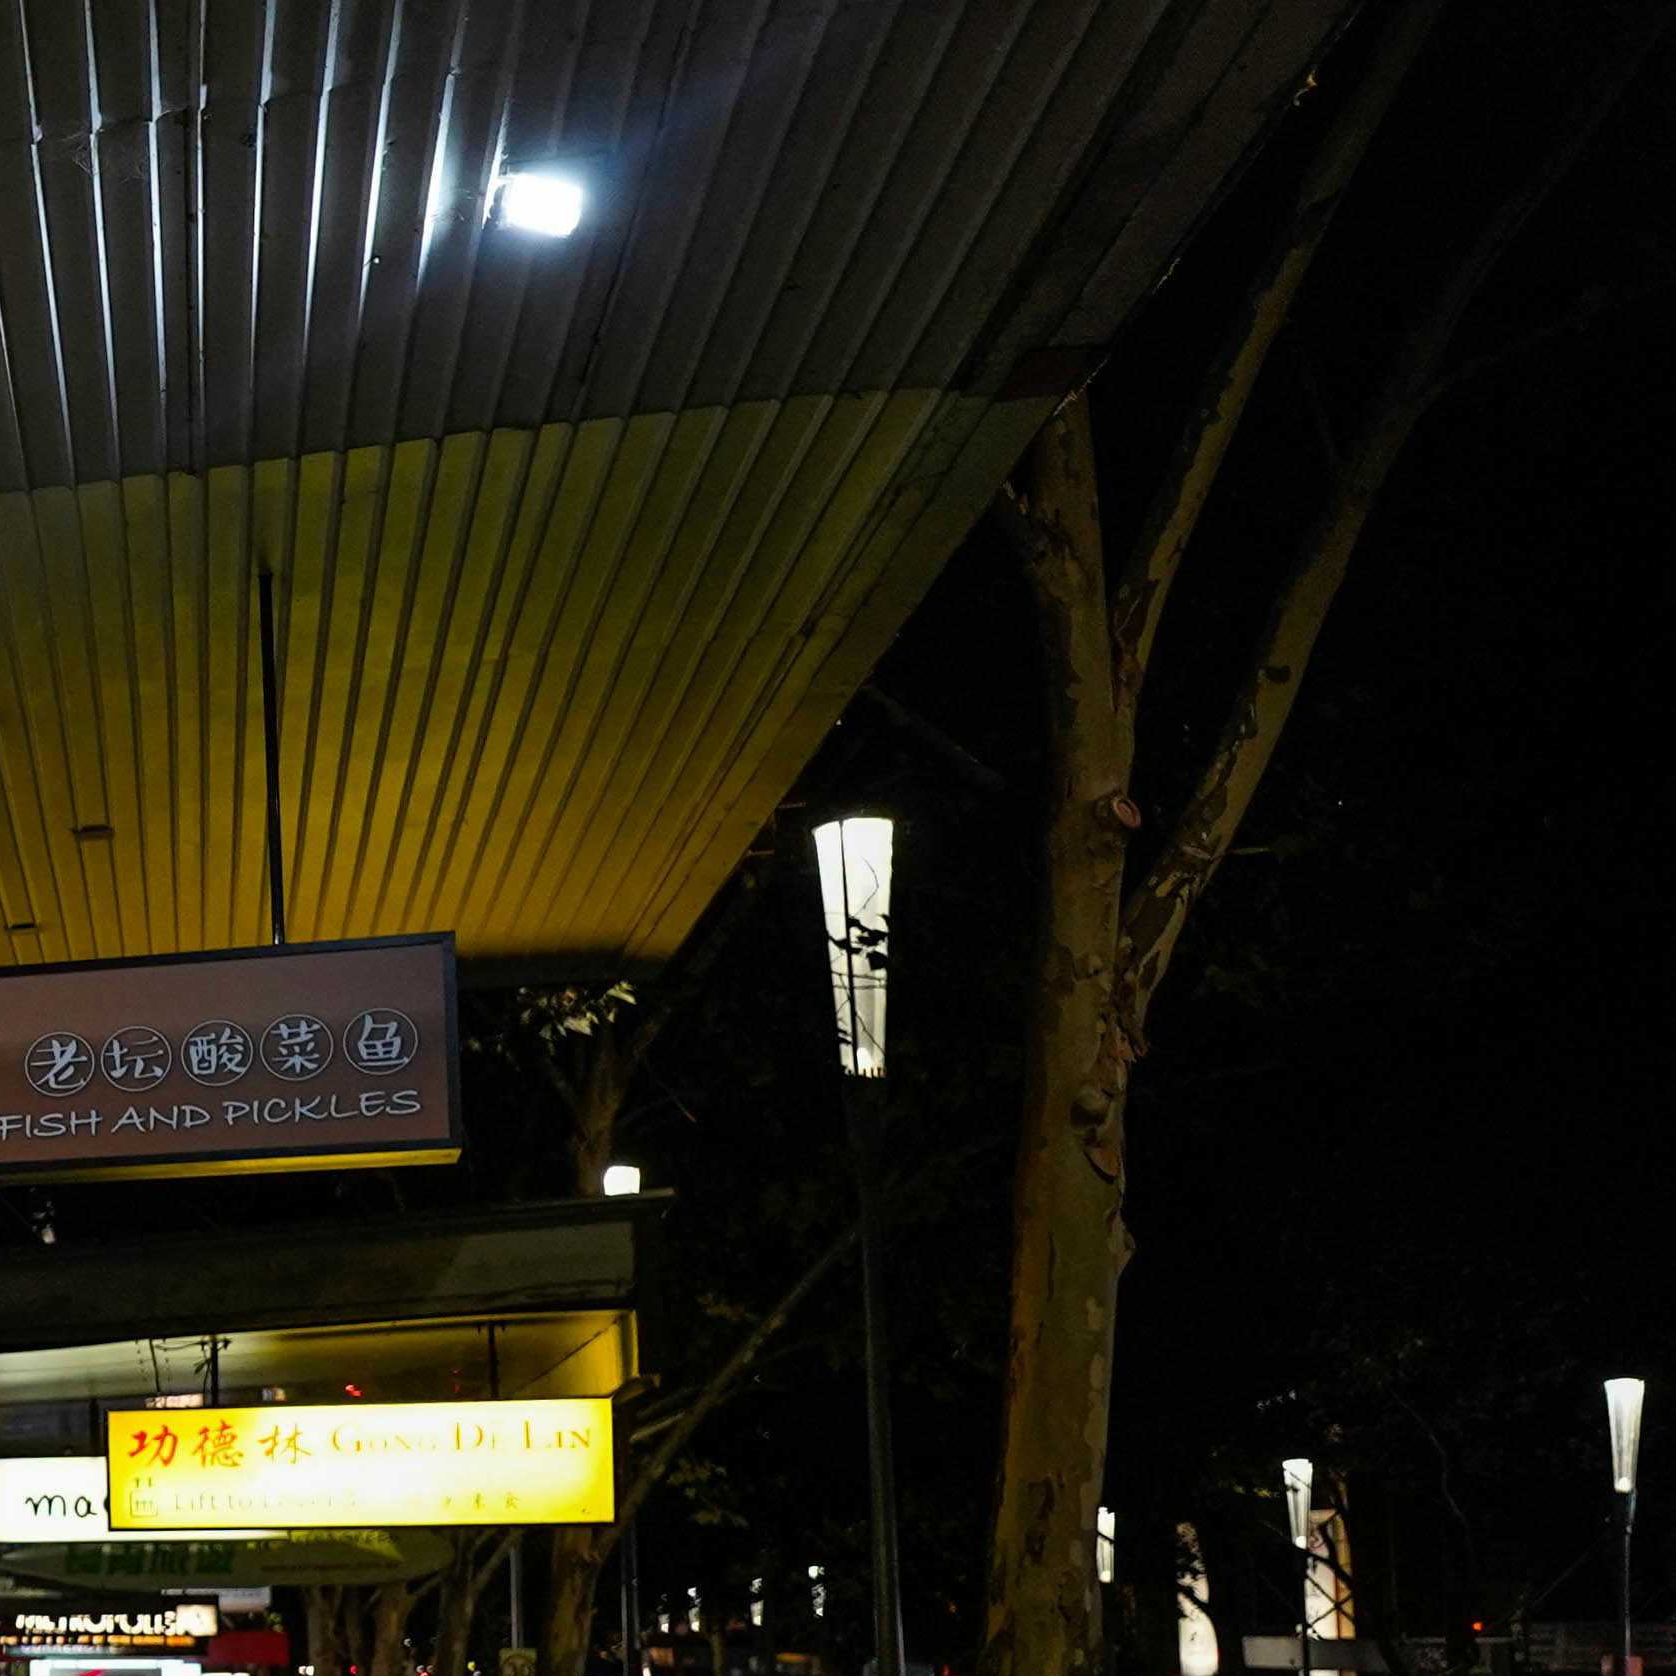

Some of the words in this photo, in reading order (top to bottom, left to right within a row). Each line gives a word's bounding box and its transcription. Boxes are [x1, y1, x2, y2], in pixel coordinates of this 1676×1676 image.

[26, 1009, 418, 1096] 老坛酸菜鱼
[0, 1109, 102, 1141] FISH
[109, 1102, 214, 1133] AND
[223, 1088, 424, 1128] PICKLES
[126, 1418, 314, 1469] 功德林
